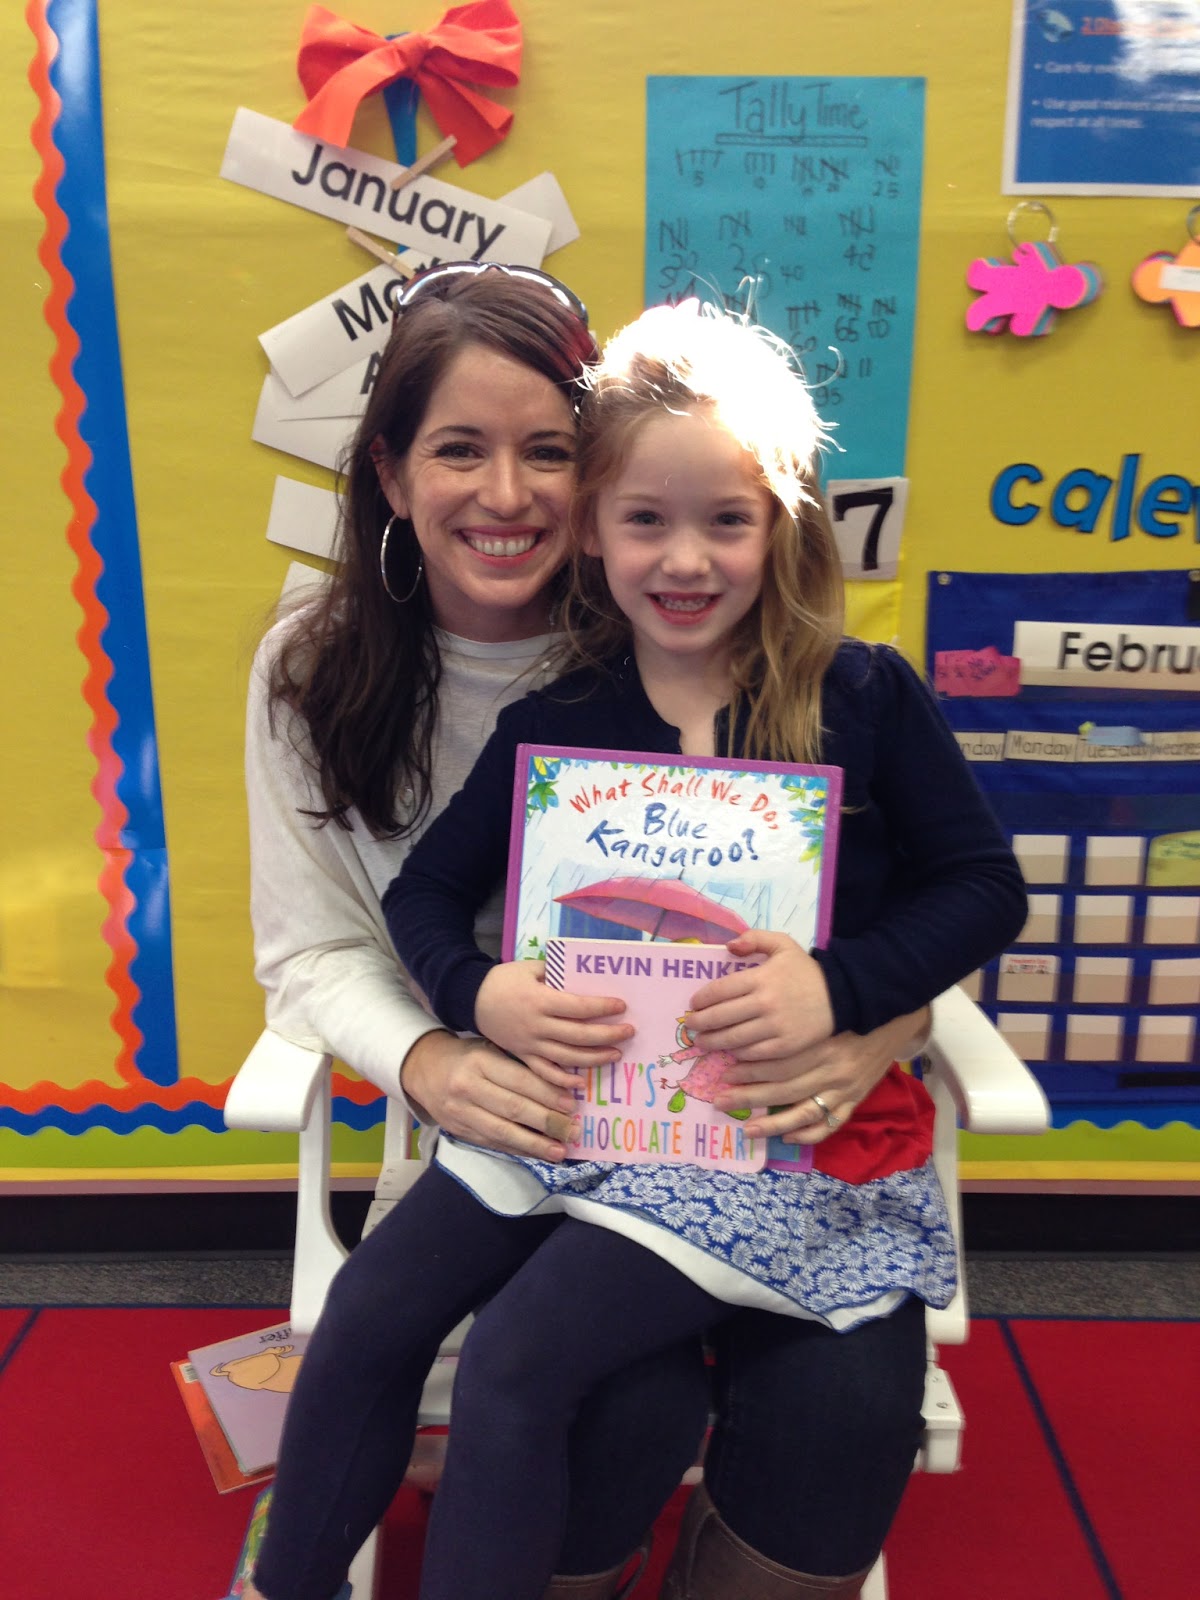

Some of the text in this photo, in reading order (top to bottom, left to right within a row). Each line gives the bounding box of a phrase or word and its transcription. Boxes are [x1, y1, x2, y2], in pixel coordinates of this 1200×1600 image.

[718, 80, 869, 144] Tally Time
[290, 143, 506, 262] January
[833, 486, 893, 571] 7
[1057, 631, 1200, 675] Febru
[961, 735, 1000, 761] nday
[1011, 734, 1073, 761] Monday
[568, 778, 633, 814] What
[641, 771, 704, 798] Shall
[710, 778, 742, 806] We
[643, 802, 709, 840] Blue
[575, 953, 652, 978] KEVIN
